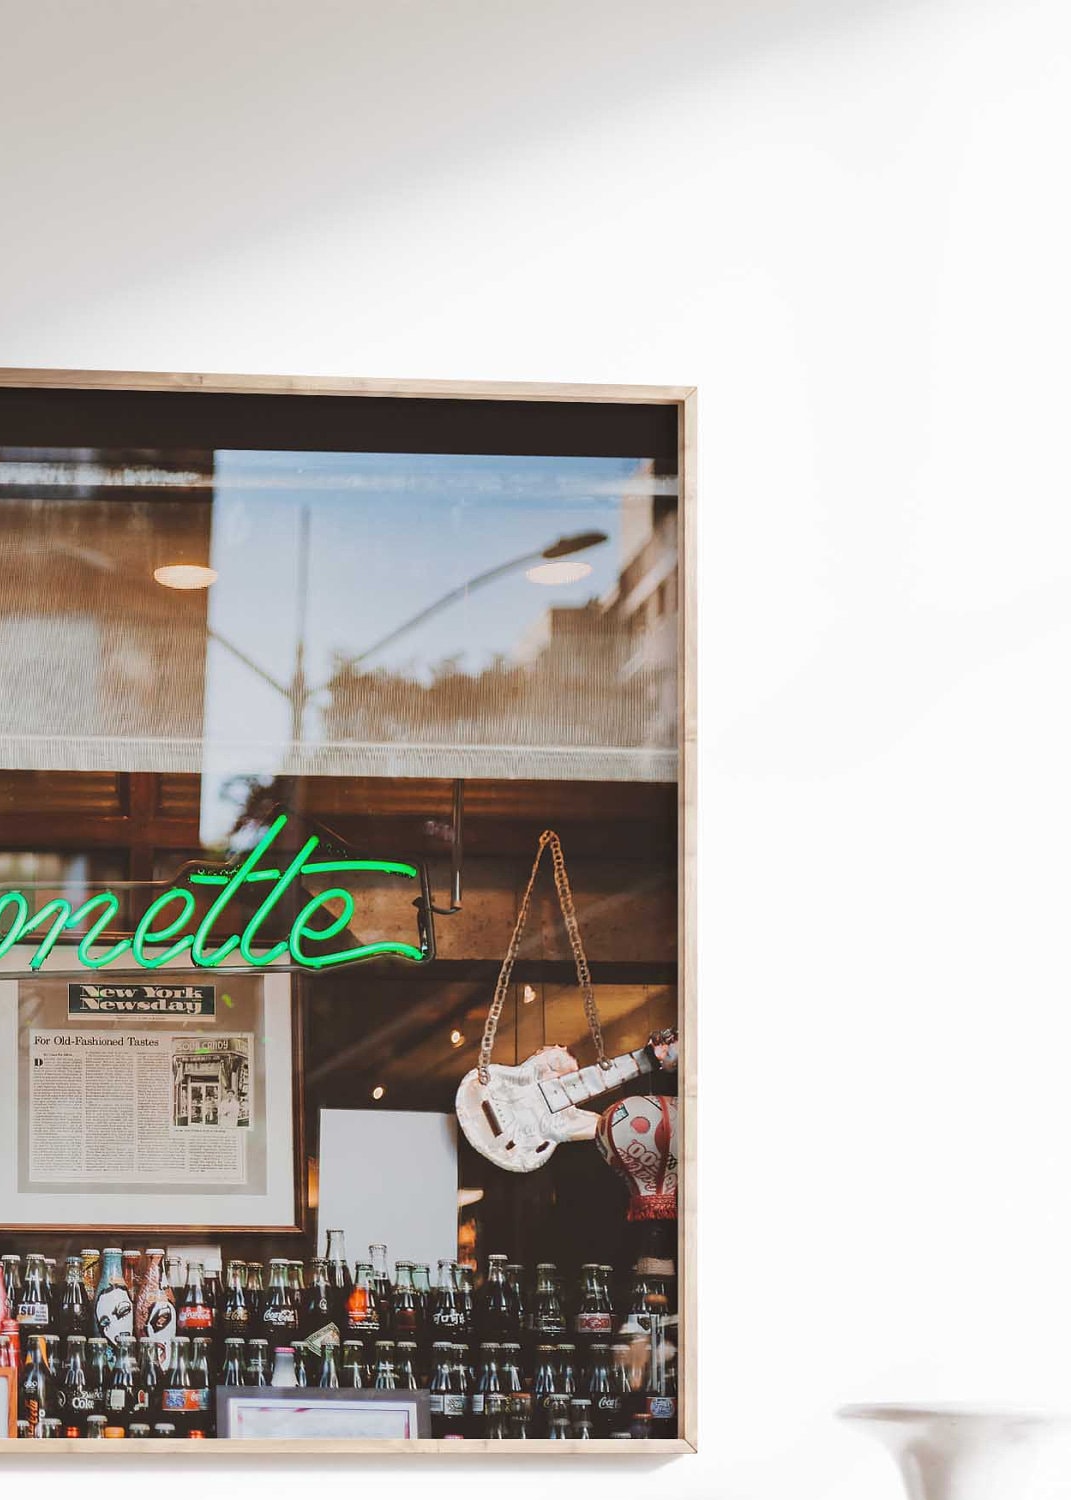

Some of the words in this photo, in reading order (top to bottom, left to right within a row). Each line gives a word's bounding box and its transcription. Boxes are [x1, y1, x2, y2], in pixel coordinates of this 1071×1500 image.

[79, 985, 138, 999] New
[142, 986, 204, 999] York
[79, 998, 203, 1015] Newsday
[34, 1035, 50, 1046] For
[53, 1035, 124, 1046] Old-Fashioned
[127, 1036, 159, 1047] Tastes
